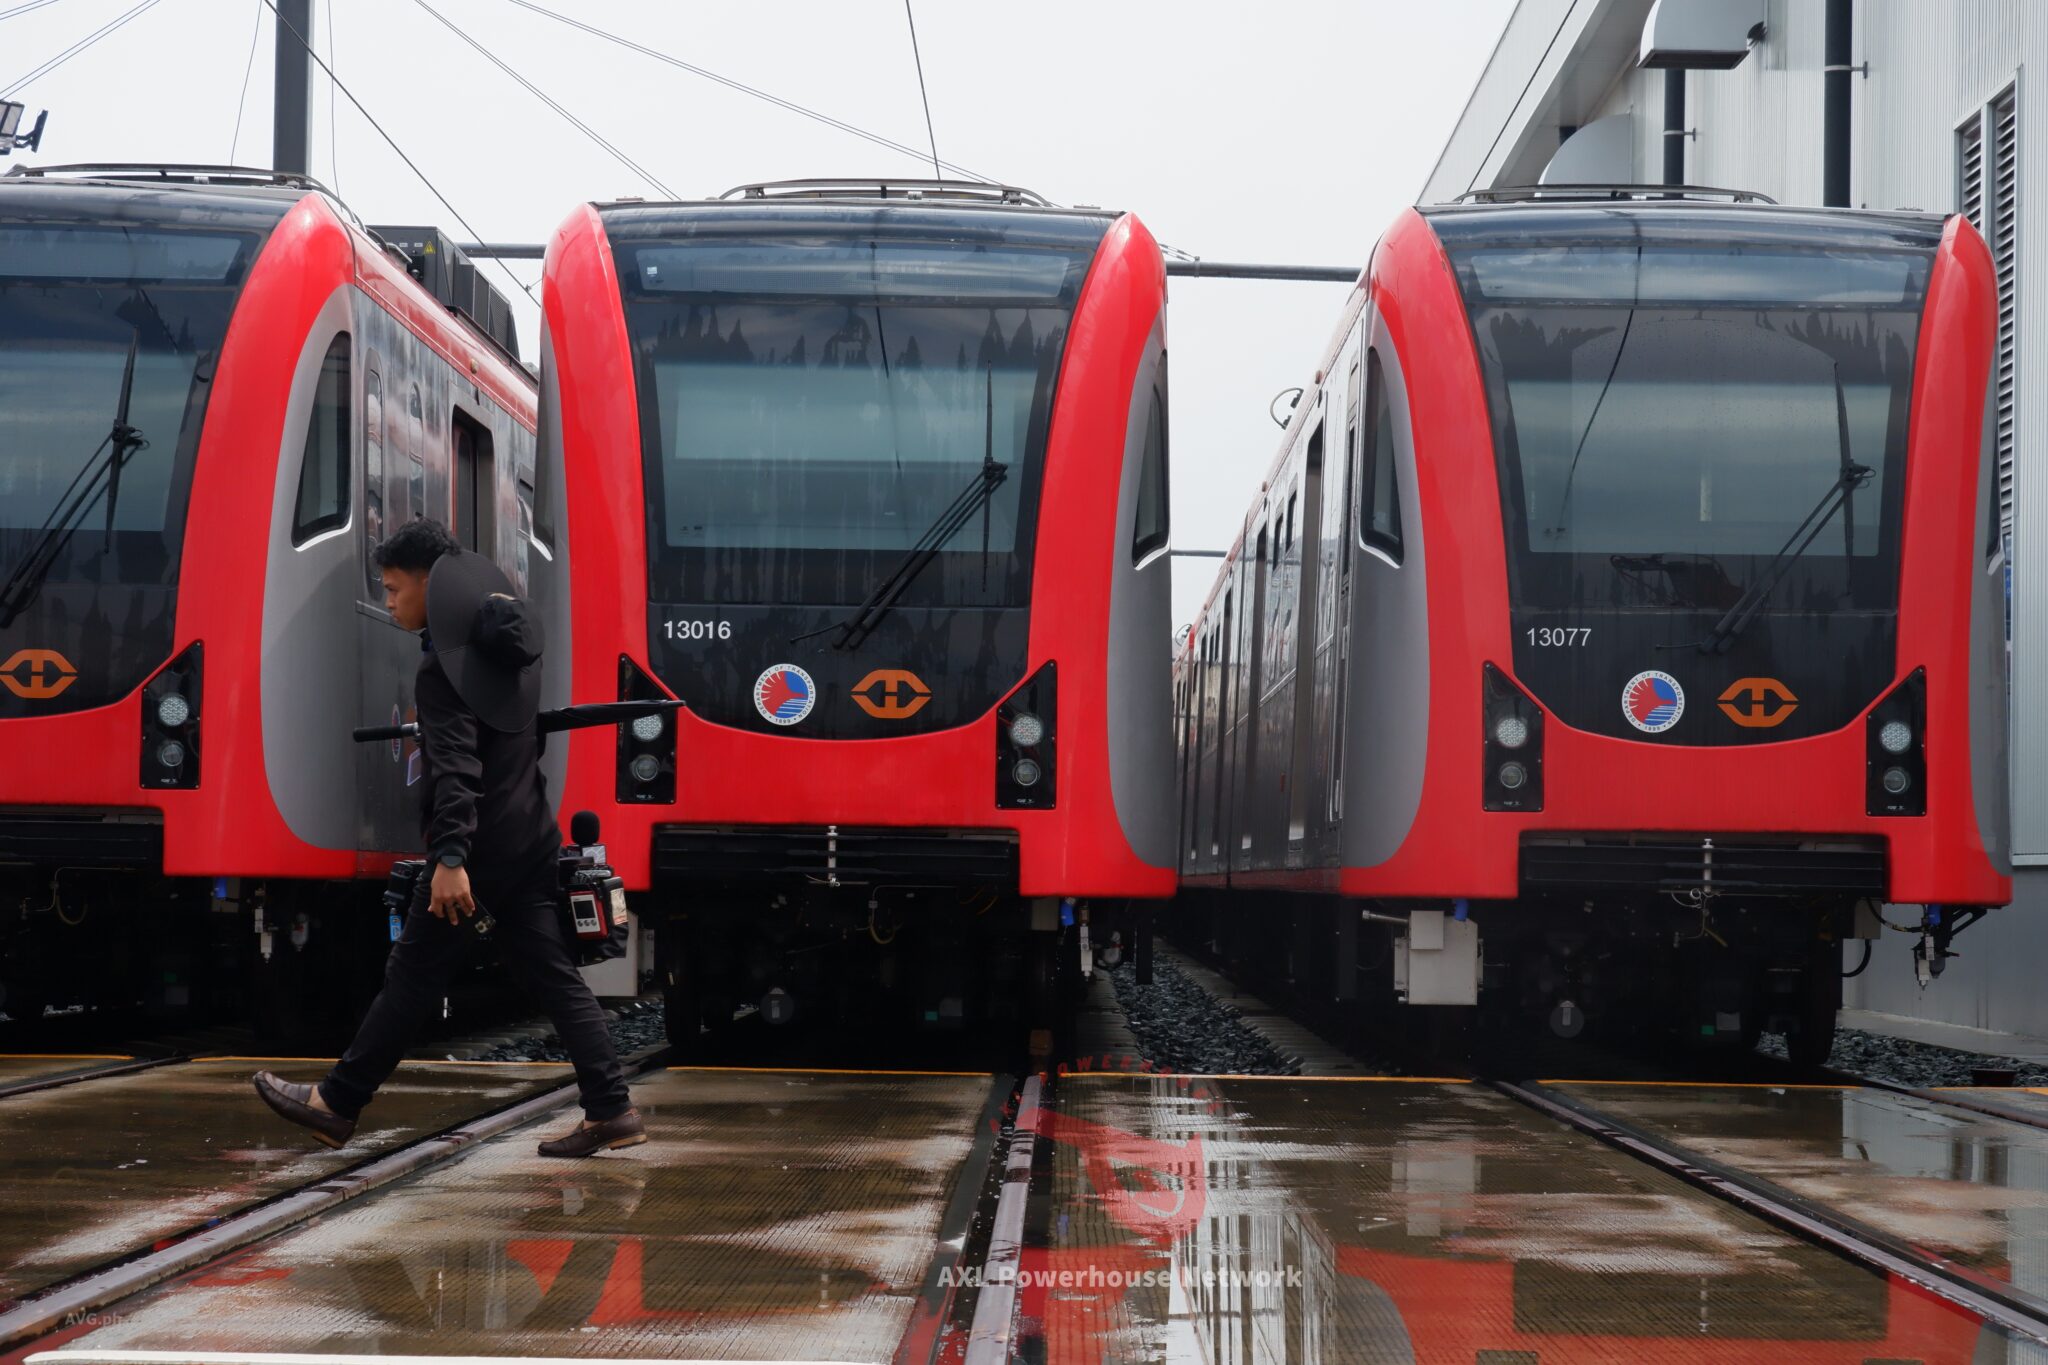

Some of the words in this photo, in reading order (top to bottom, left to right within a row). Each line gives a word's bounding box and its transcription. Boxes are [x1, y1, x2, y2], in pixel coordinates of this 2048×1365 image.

[664, 620, 731, 639] 13016
[1527, 627, 1592, 647] 13077
[755, 670, 771, 715] DEPARTMENT
[787, 665, 814, 718] TRANSPORTATION
[1623, 677, 1639, 723] DEPARTMENT
[1655, 672, 1683, 725] TRANSPORTATION
